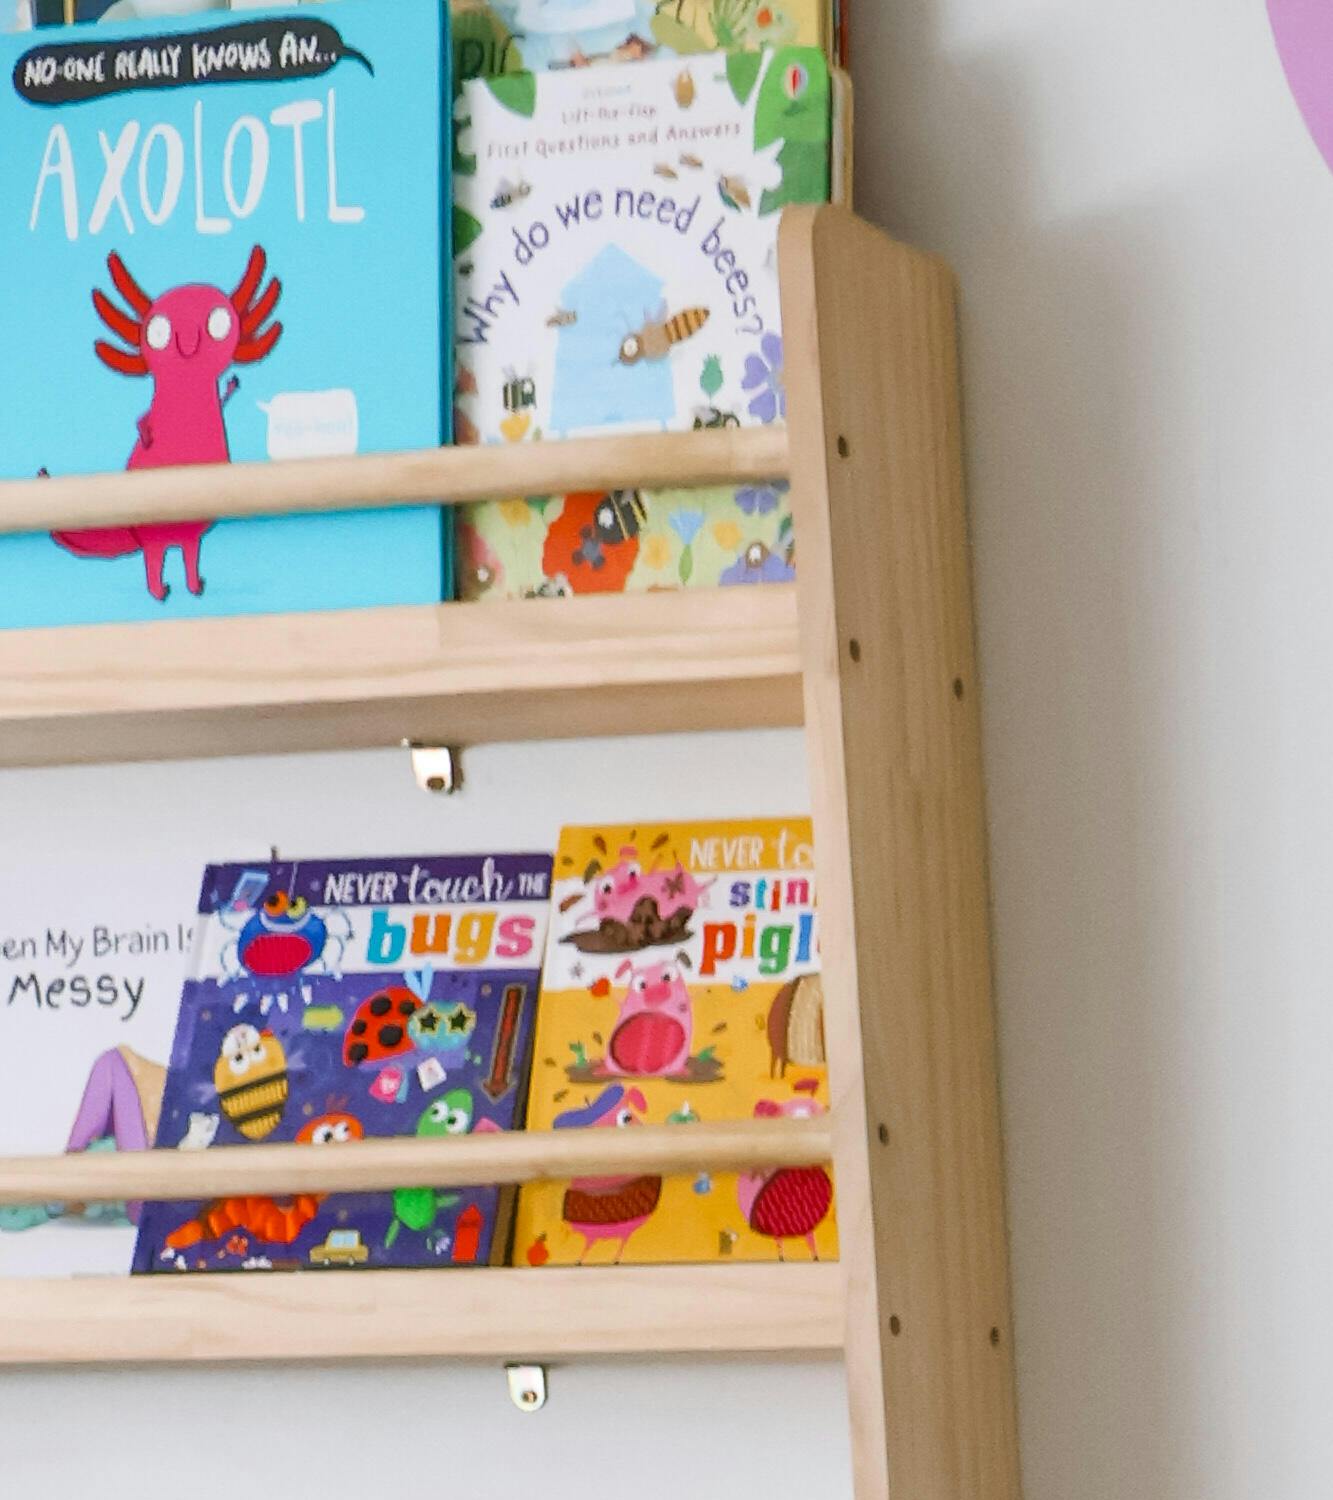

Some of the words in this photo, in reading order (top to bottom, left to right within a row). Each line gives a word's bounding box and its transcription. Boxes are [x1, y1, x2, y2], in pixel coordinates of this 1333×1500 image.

[114, 44, 182, 80] REALLY
[191, 37, 270, 78] KNOWS
[486, 140, 529, 158] First
[534, 132, 620, 159] Questions
[628, 128, 658, 145] and
[666, 121, 741, 140] Answers
[29, 88, 365, 241] AXOLOTL
[460, 269, 520, 346] Why
[511, 221, 550, 265] do
[555, 189, 603, 229] we
[613, 185, 700, 235] need
[700, 216, 764, 335] bees?
[690, 835, 764, 868] NEVER
[324, 870, 398, 904] NEVER
[401, 857, 514, 905] touch
[518, 872, 548, 896] THE
[729, 877, 817, 911] stin
[46, 927, 84, 968] My
[93, 924, 170, 957] Brain
[366, 906, 536, 966] bugs
[698, 912, 821, 976] pigl
[8, 972, 145, 1022] Messy
